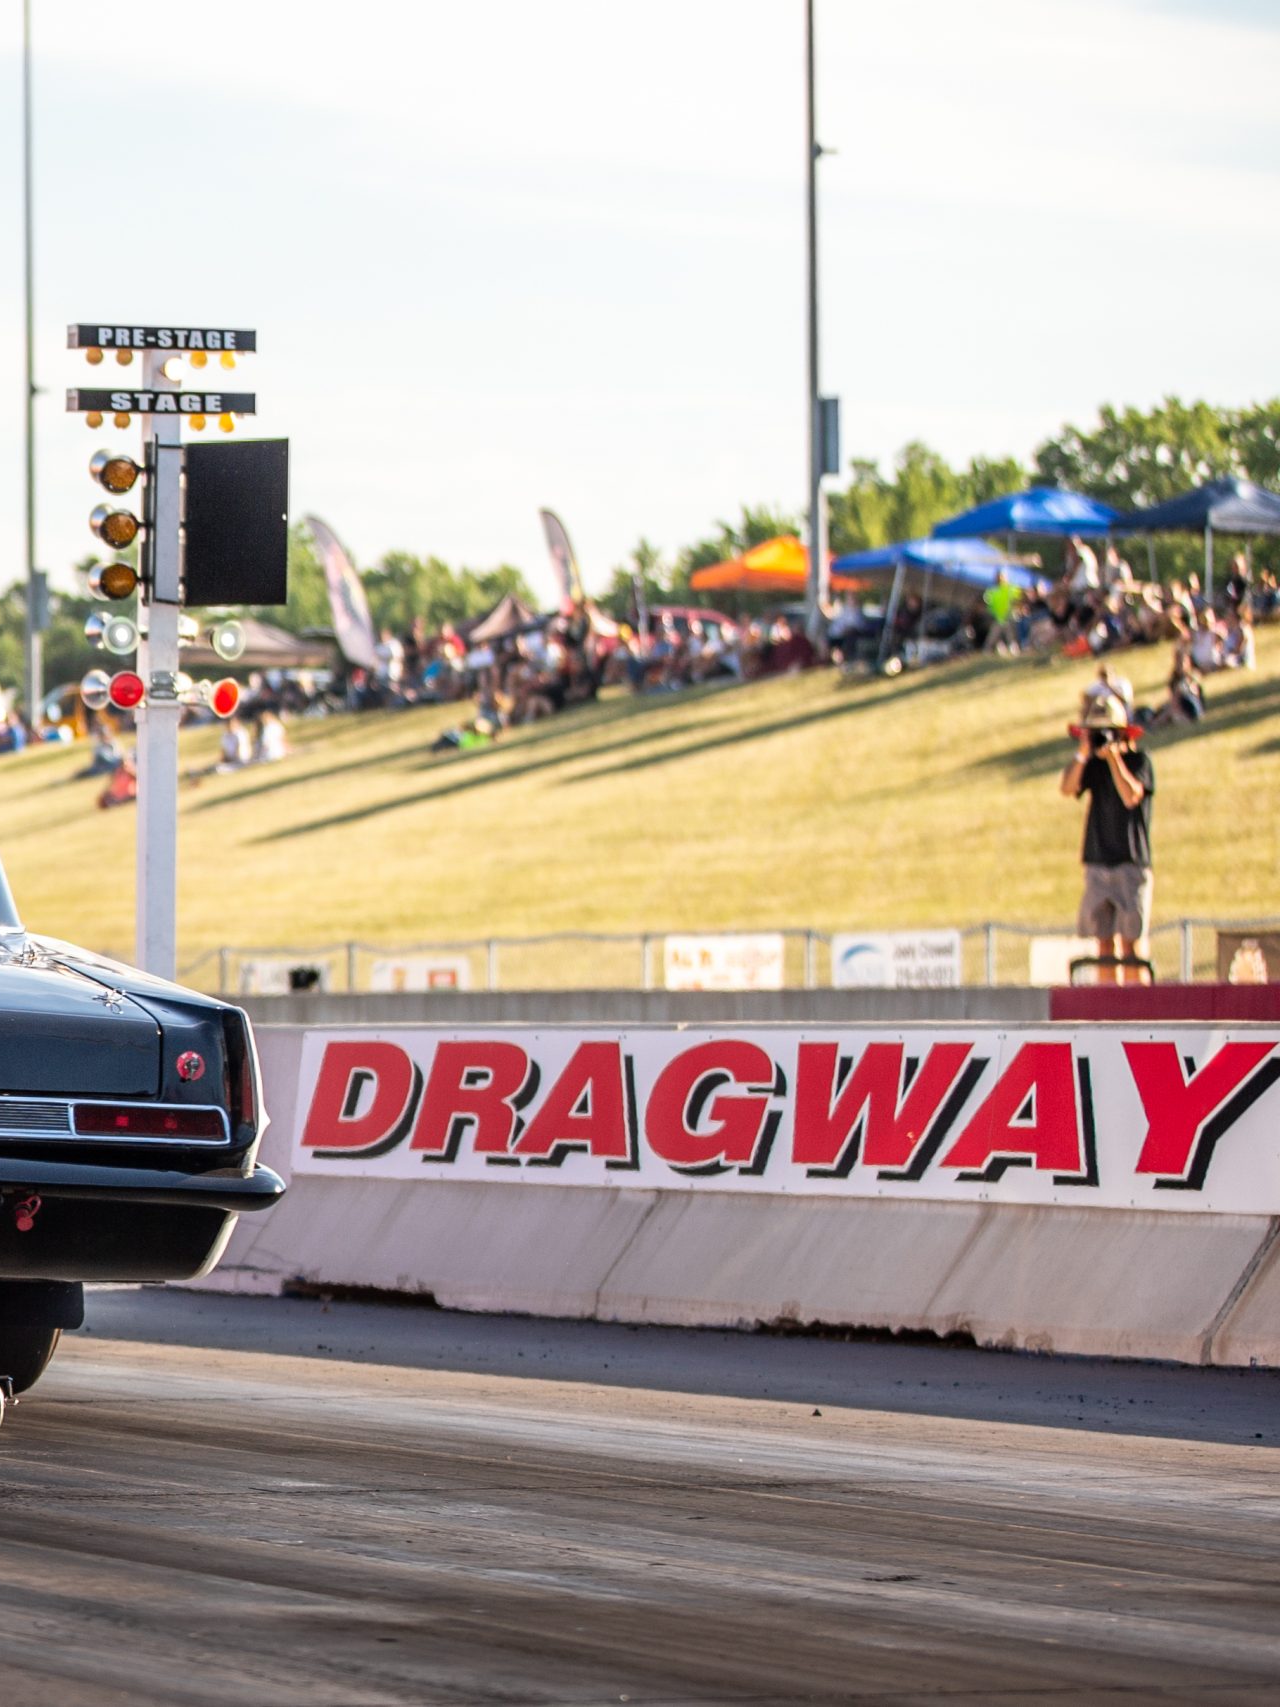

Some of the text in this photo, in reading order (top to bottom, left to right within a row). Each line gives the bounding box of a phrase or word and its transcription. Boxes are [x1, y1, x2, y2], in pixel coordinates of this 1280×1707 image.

[97, 326, 237, 350] PRE-STAGE
[110, 392, 223, 412] STAGE
[300, 1040, 1280, 1189] DRAGWAY
